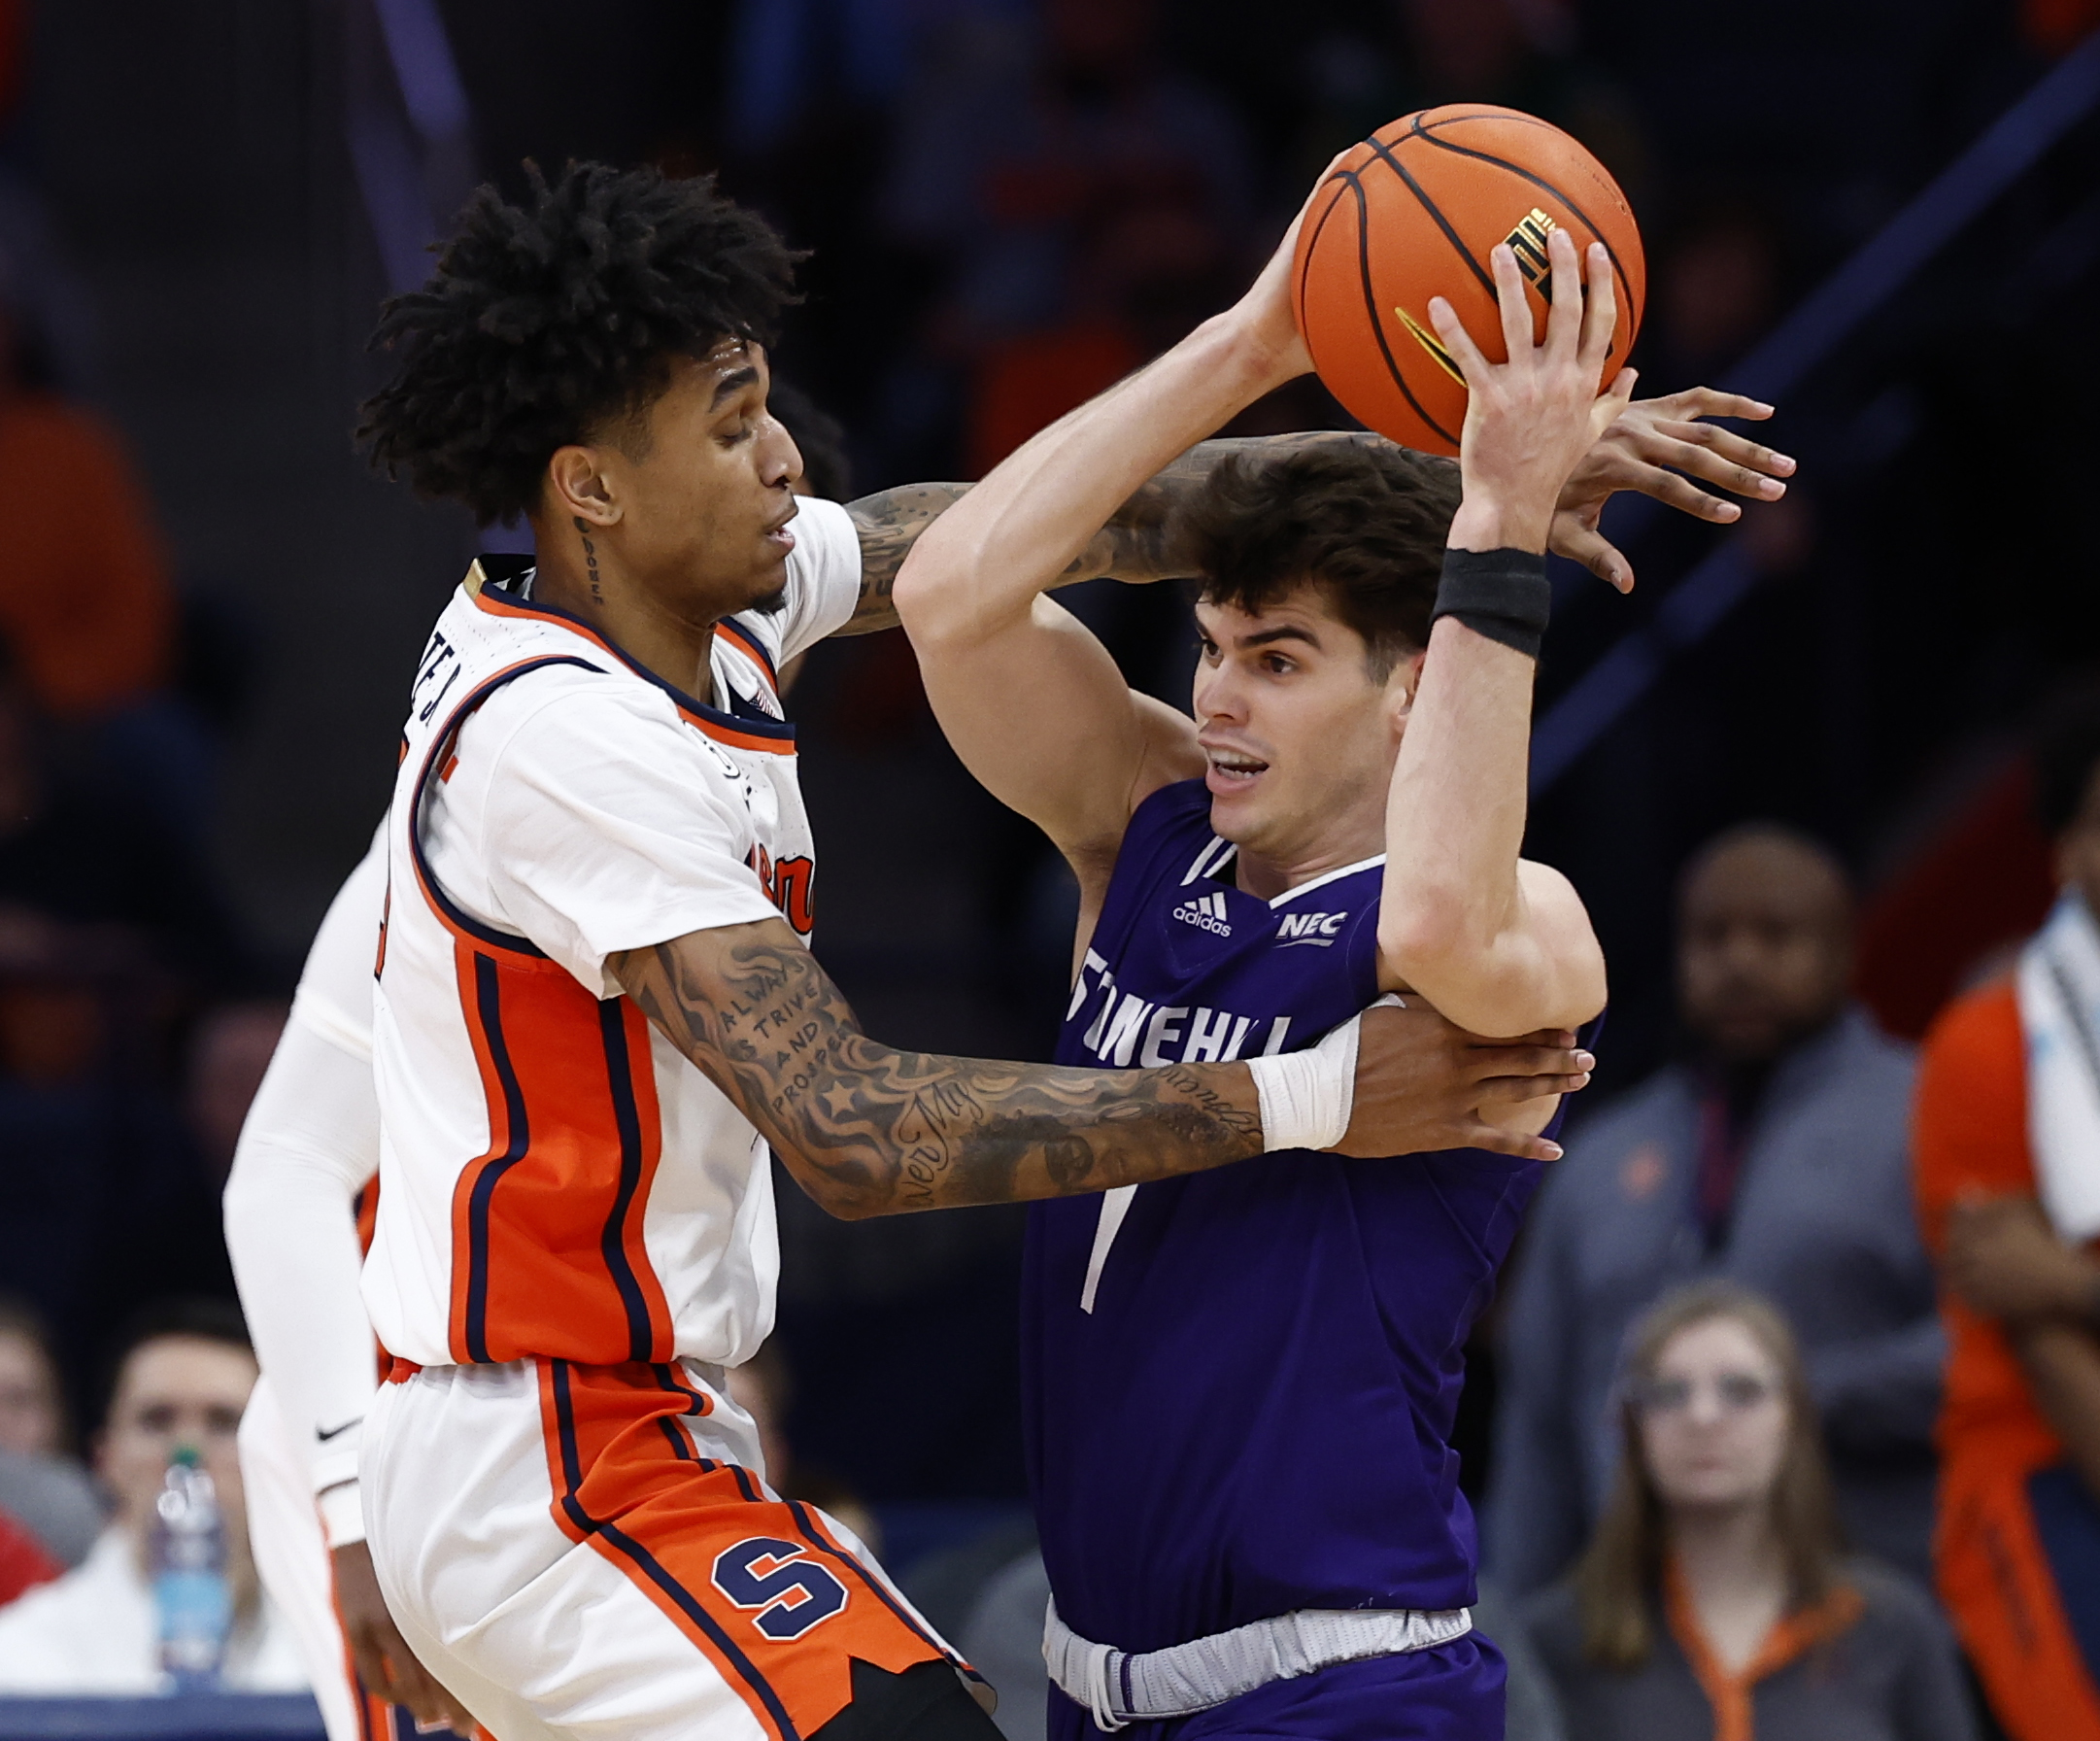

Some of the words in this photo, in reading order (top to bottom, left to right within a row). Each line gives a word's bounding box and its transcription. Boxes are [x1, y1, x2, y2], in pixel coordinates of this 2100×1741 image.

[1172, 907, 1232, 938] adidas
[1274, 911, 1348, 939] NEC
[777, 1022, 818, 1069] AND
[711, 1536, 850, 1640] S
